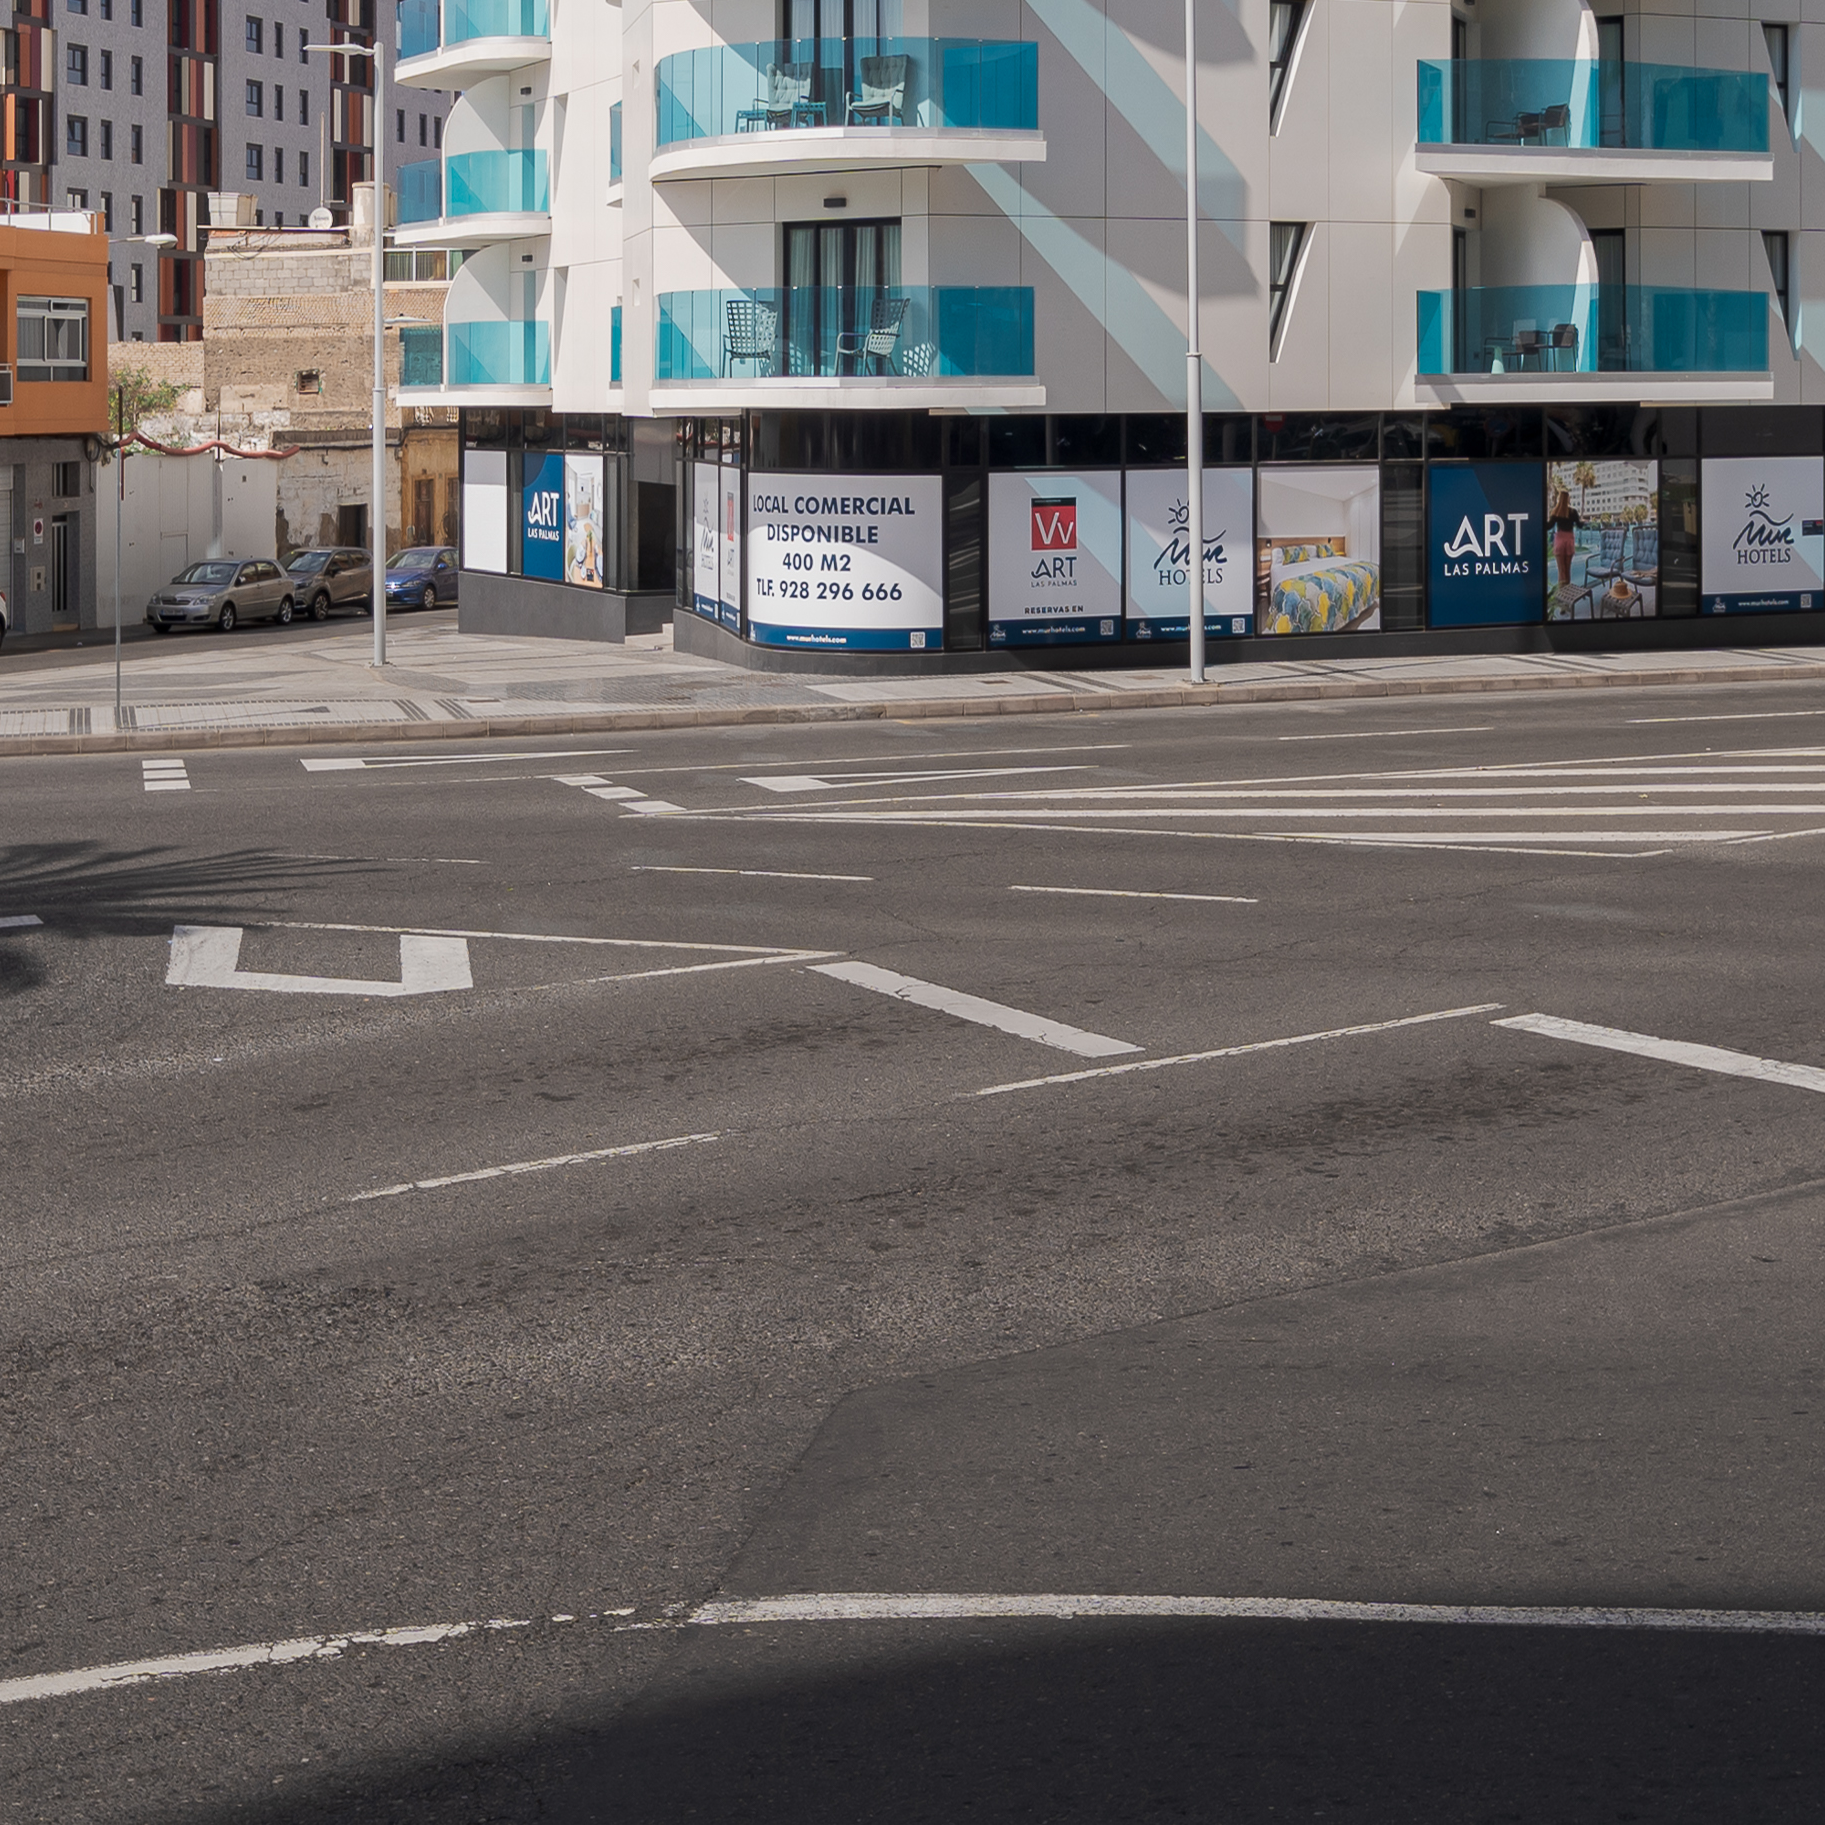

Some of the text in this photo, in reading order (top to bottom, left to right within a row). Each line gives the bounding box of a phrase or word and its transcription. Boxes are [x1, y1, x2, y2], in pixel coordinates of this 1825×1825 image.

[528, 491, 560, 526] ART
[753, 494, 915, 515] LOCAL COMERCIAL
[528, 528, 559, 542] LAS PALMAS
[767, 524, 878, 543] DISPONIBLE
[1444, 513, 1529, 558] ART
[783, 553, 851, 571] 400 M2
[1737, 548, 1791, 564] HOTELS
[1031, 556, 1077, 579] ART
[1444, 561, 1529, 576] LAS PALMAS
[1159, 568, 1223, 585] HOLS
[757, 578, 775, 597] TLF.
[780, 580, 809, 599] 928
[817, 582, 854, 600] 296
[862, 583, 902, 601] 666
[1025, 605, 1084, 614] RESERVAS EN
[1022, 625, 1086, 635] www.murhotels.com
[786, 634, 847, 644] www.murhotels.com
